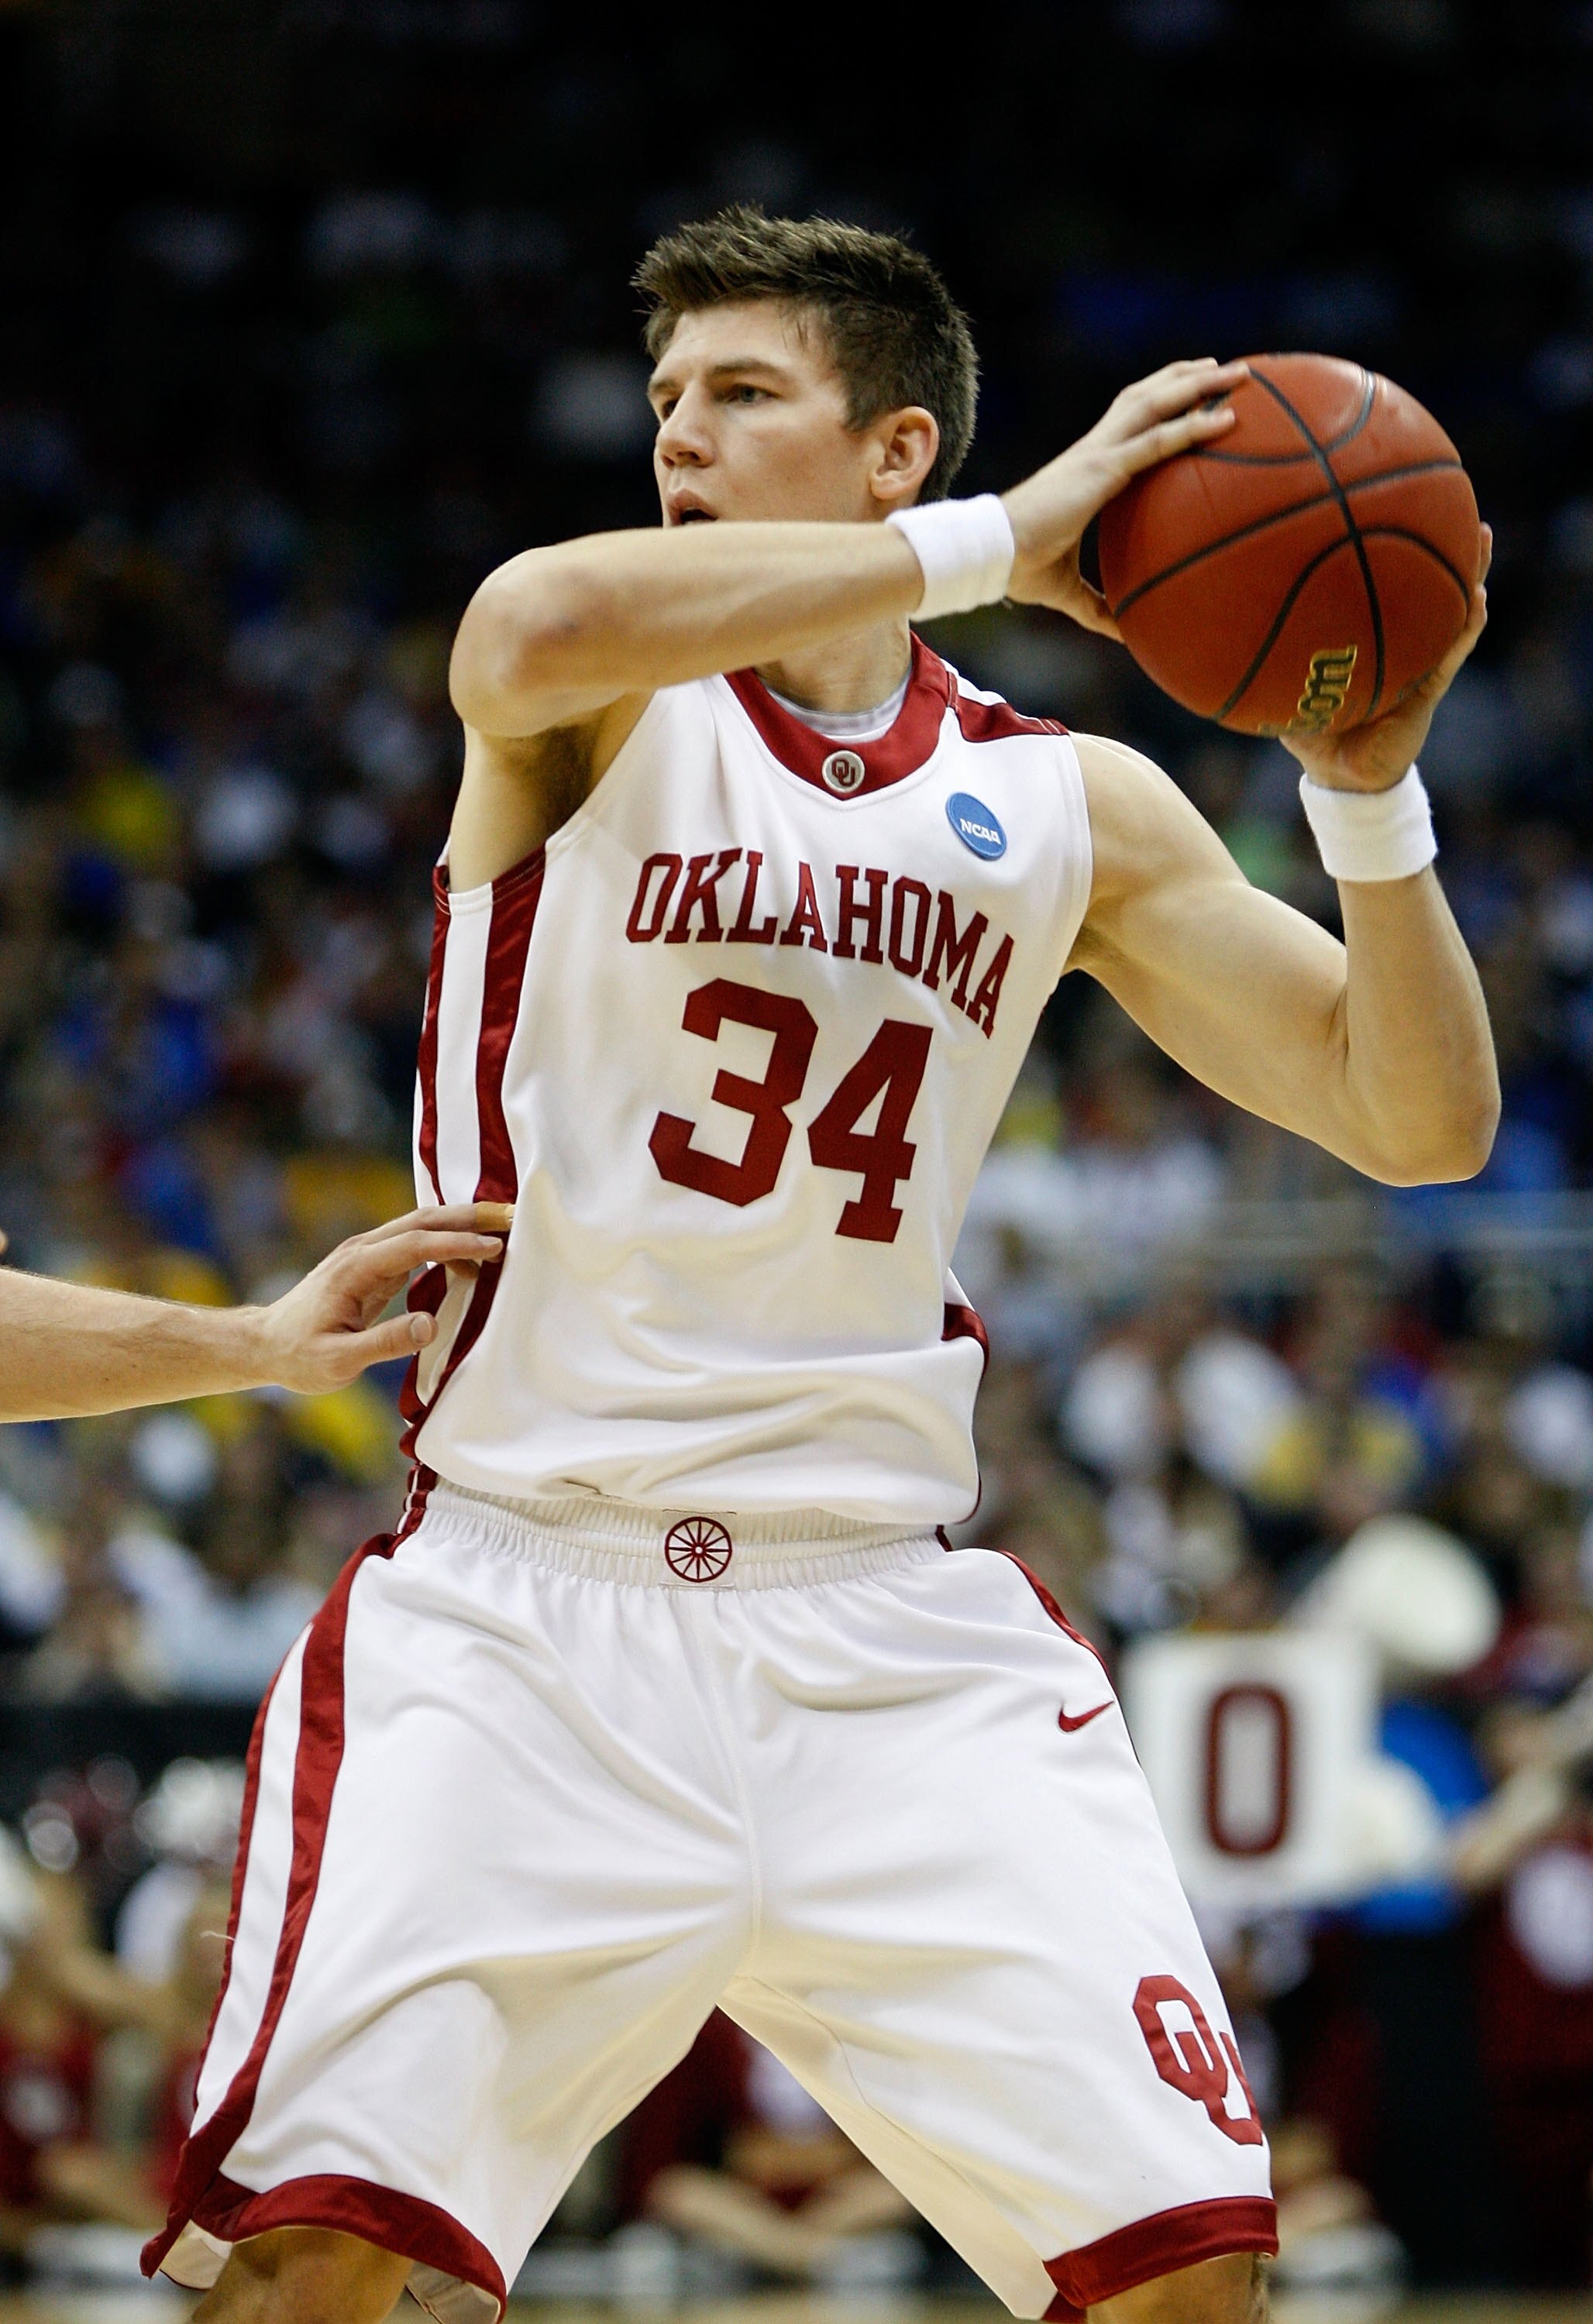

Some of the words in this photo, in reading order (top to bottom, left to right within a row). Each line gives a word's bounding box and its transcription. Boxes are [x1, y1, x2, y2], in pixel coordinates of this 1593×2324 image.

[832, 759, 855, 786] OU
[959, 818, 1001, 844] NCAA
[626, 847, 1015, 1040] OKLAHOMA
[649, 978, 934, 1243] 34
[1132, 1974, 1264, 2145] OU
